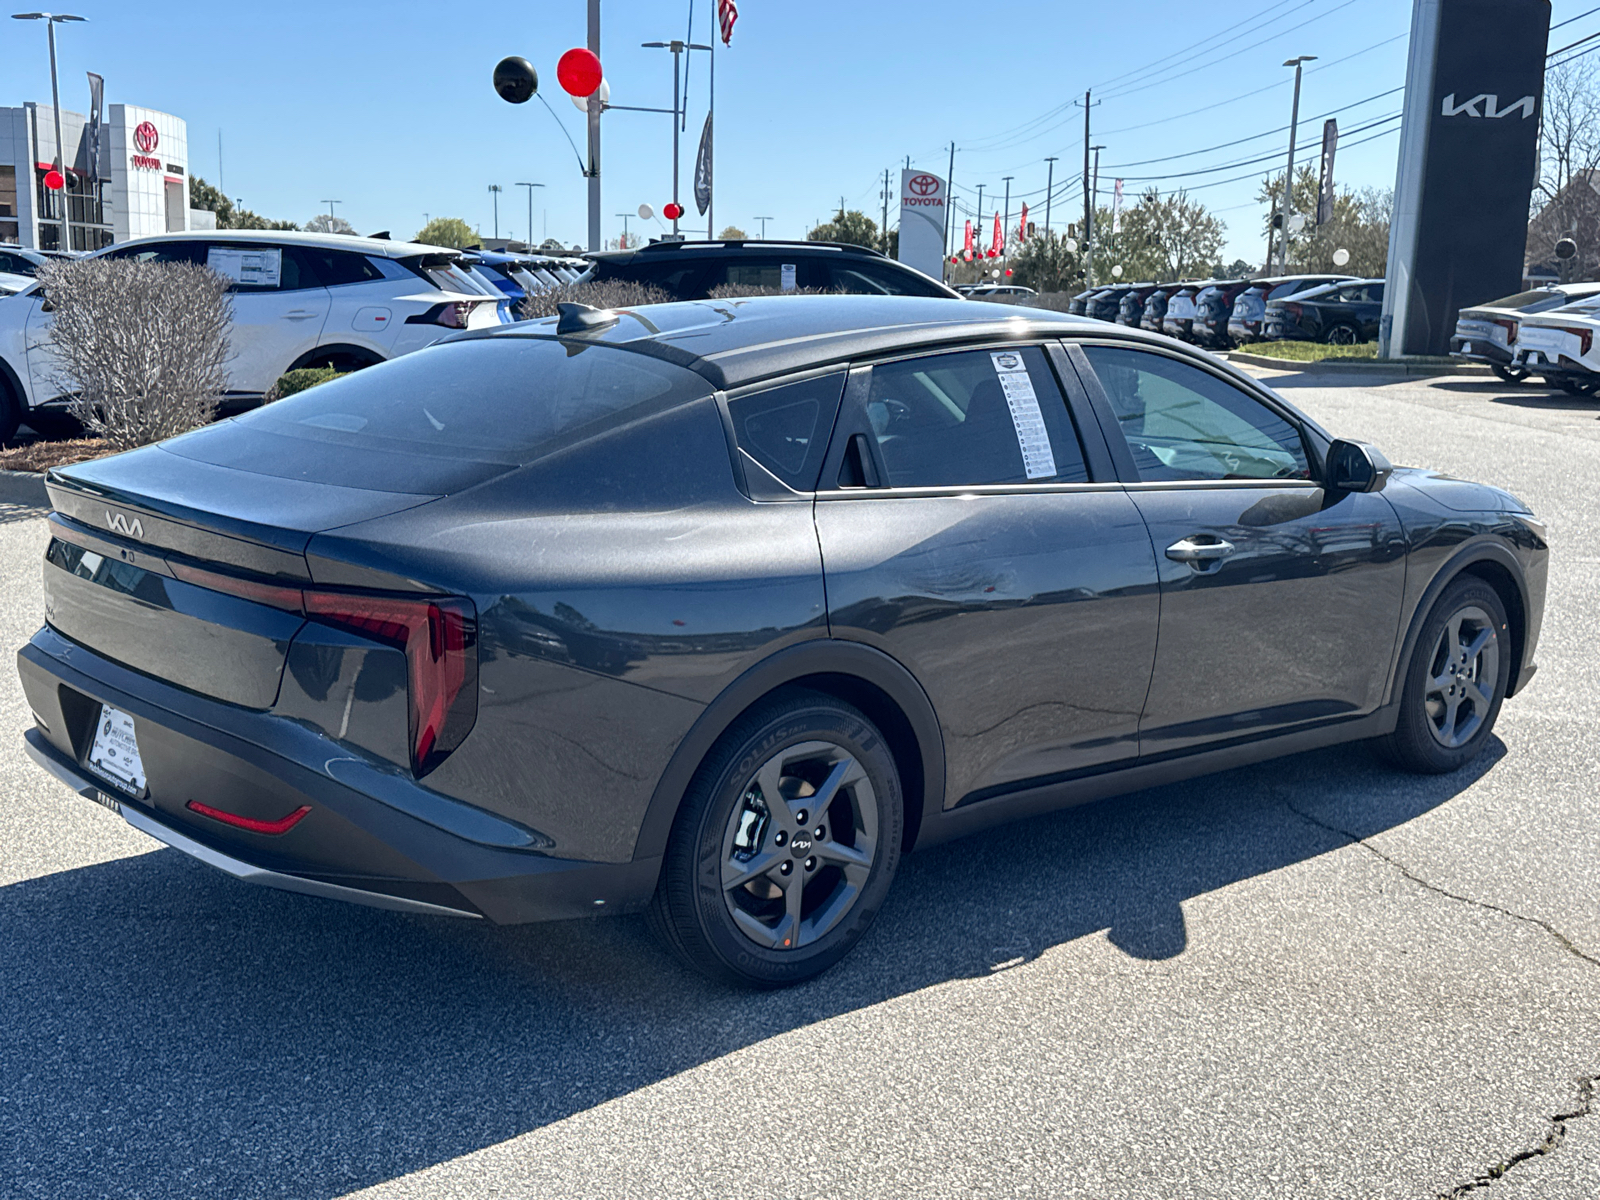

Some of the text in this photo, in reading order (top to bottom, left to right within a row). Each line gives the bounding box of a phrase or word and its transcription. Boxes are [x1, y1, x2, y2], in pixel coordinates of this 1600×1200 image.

[1442, 93, 1535, 119] KIA
[132, 155, 162, 170] TOYOTA
[903, 197, 943, 206] TOYOTA
[105, 510, 144, 538] KIA
[730, 727, 787, 786] SOLUS
[791, 840, 812, 849] KIA
